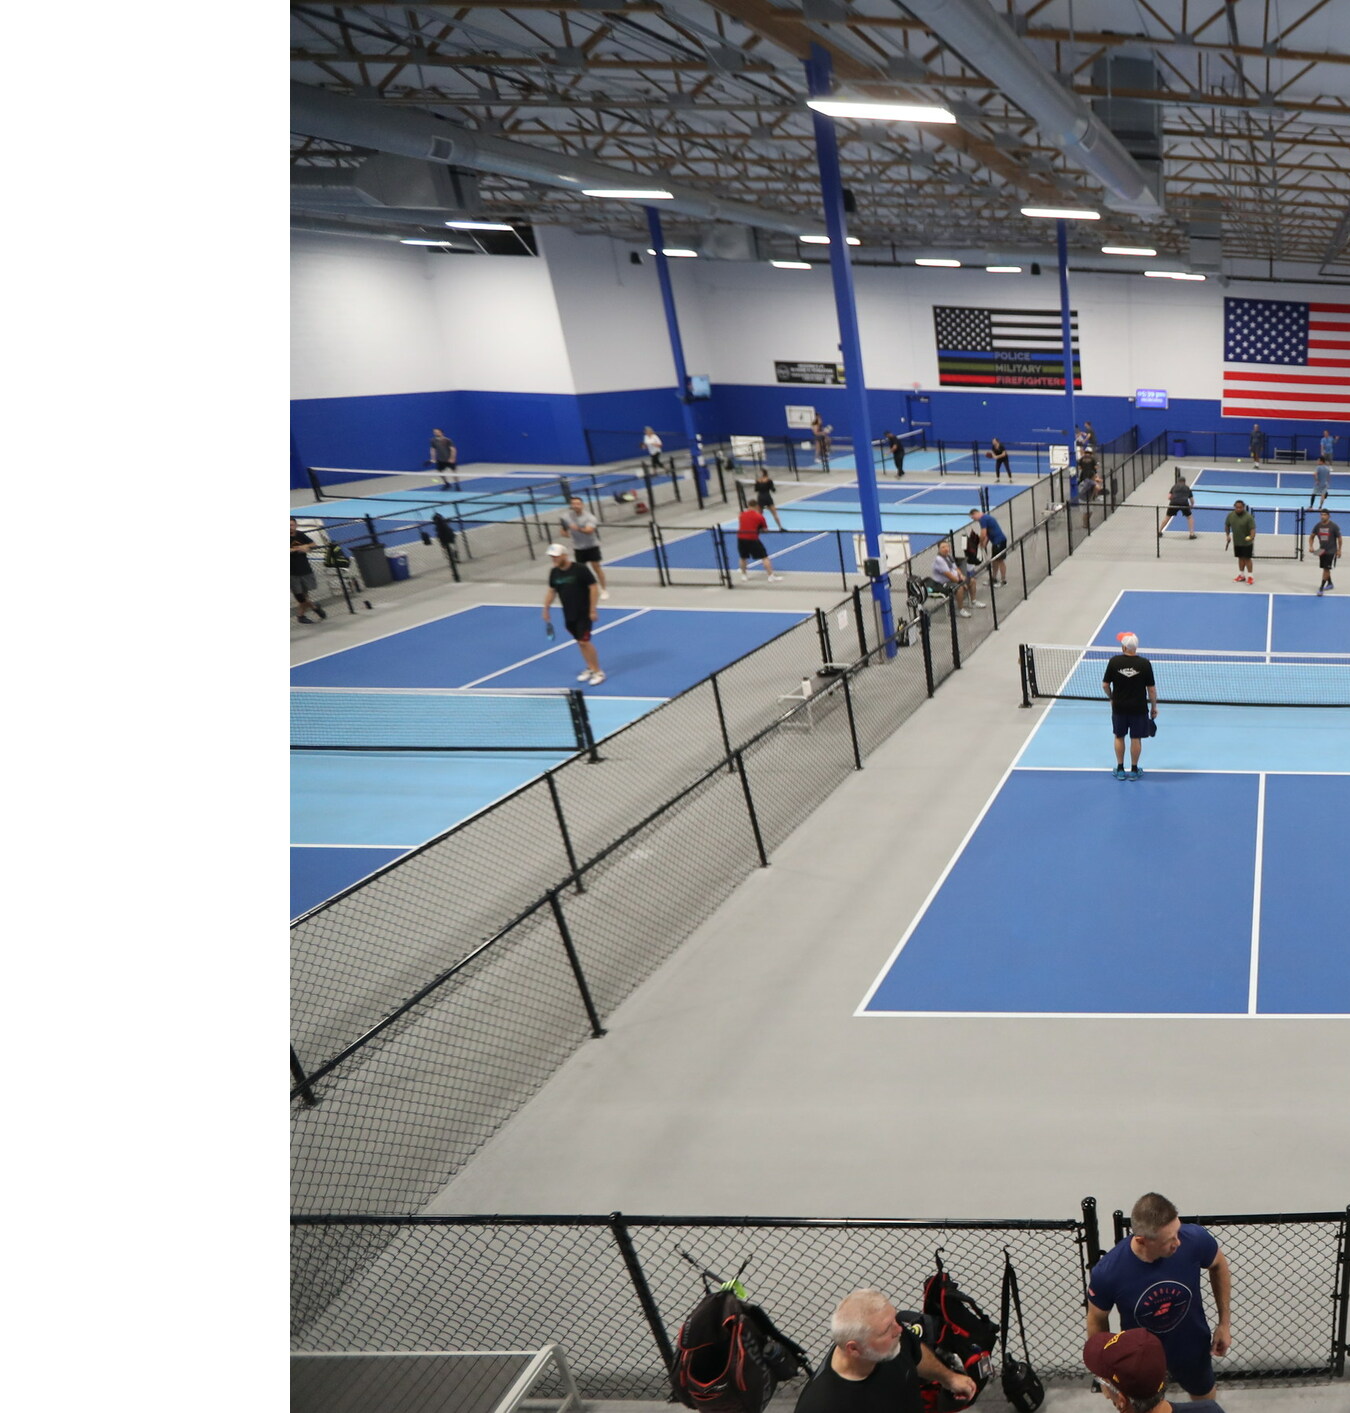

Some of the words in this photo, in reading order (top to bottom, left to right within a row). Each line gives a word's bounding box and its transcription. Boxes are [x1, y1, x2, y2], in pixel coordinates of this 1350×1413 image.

[994, 351, 1031, 361] POLICE
[995, 364, 1042, 373] MILITARY
[996, 375, 1061, 386] FIREFIGHTER
